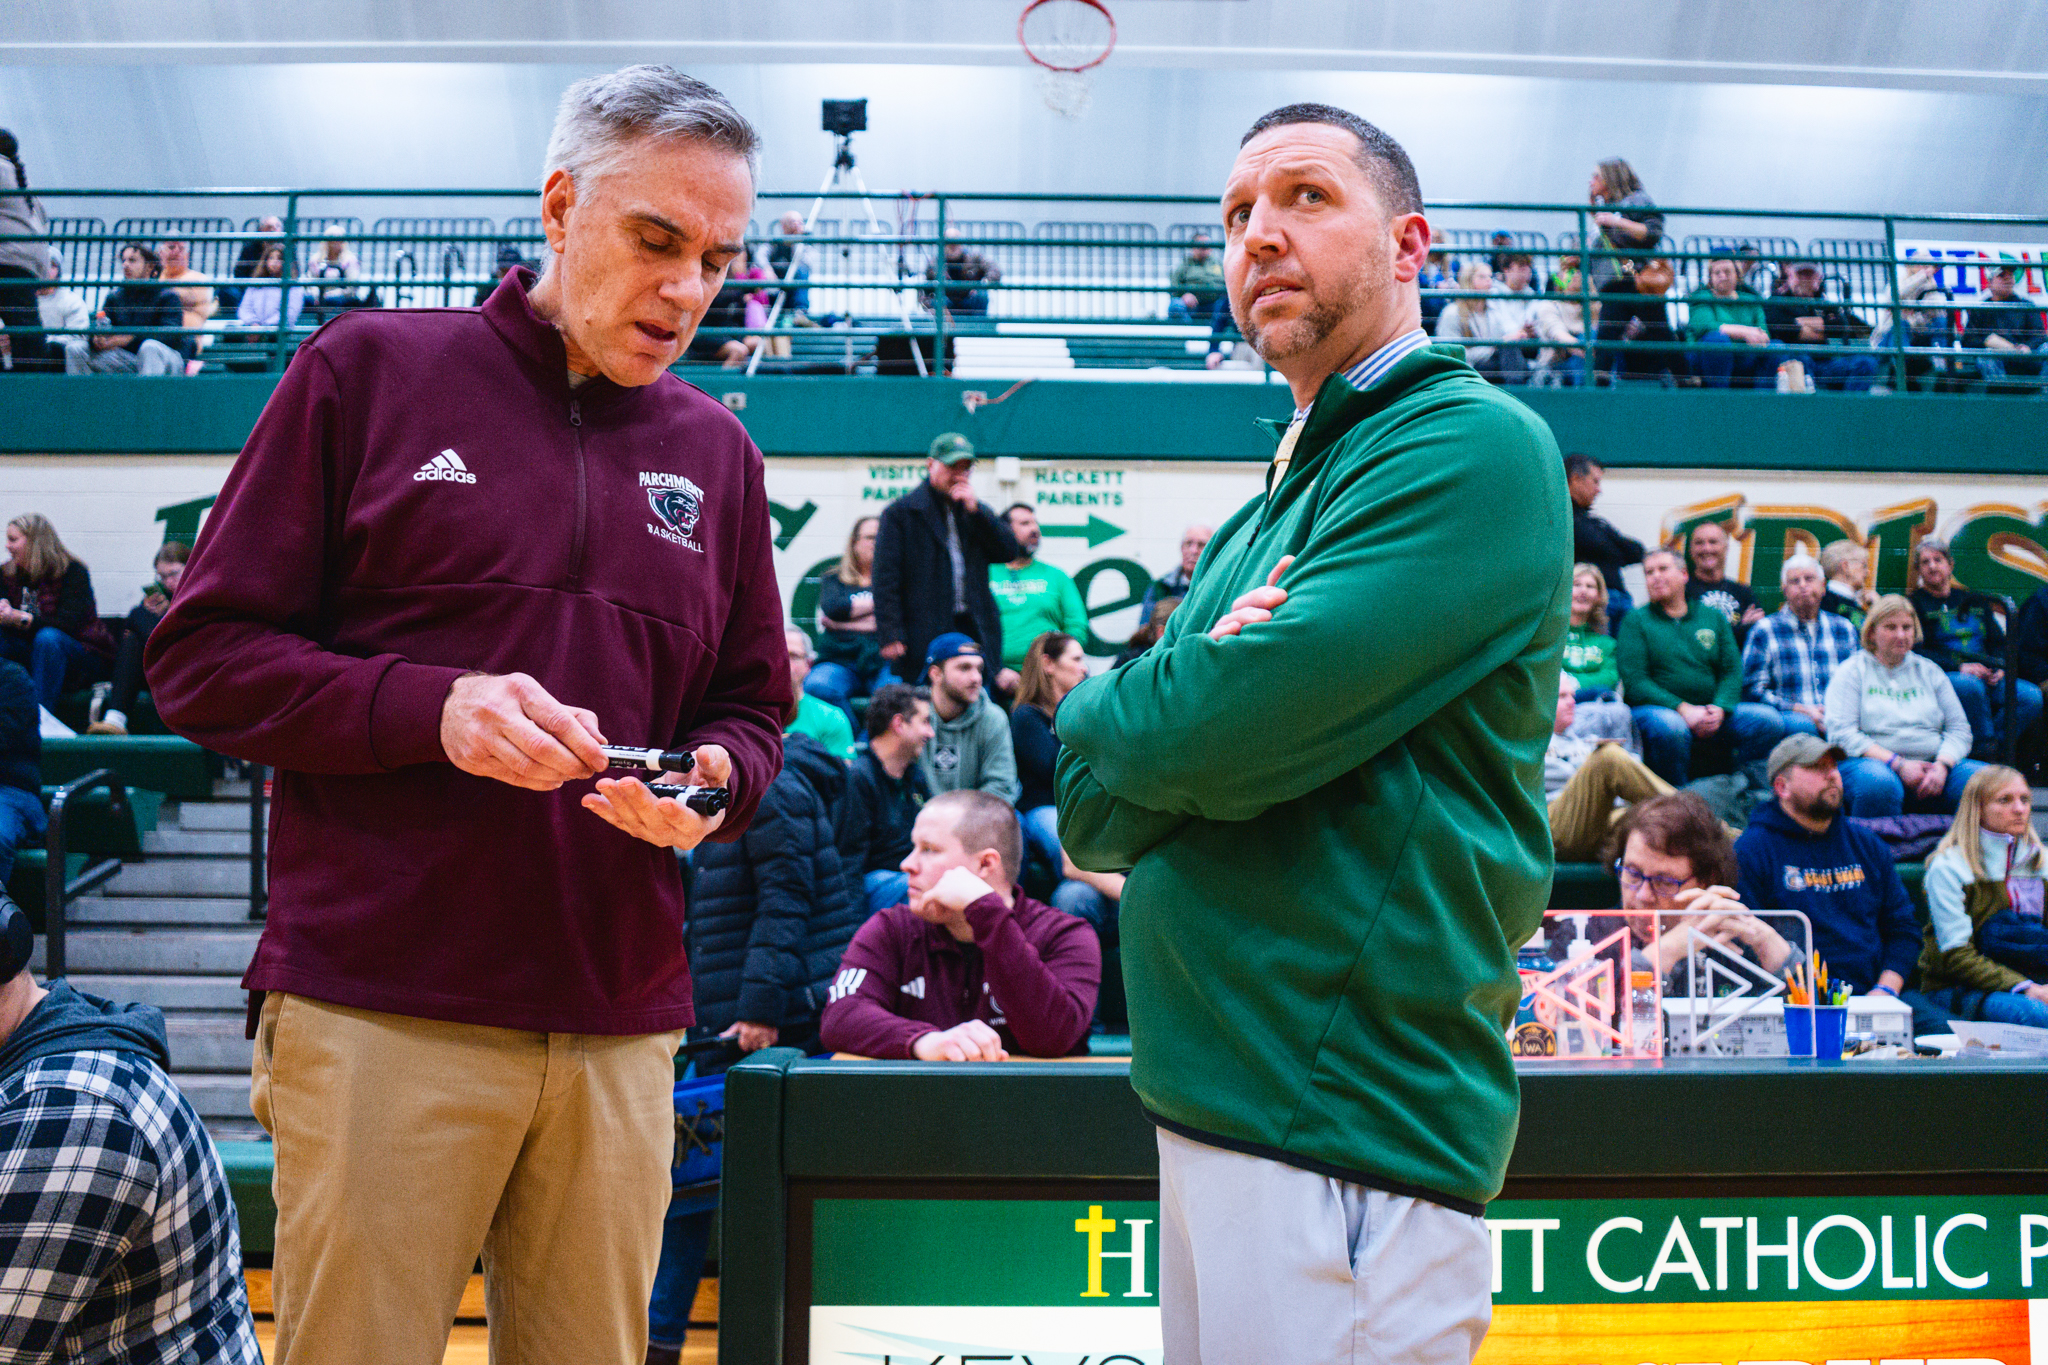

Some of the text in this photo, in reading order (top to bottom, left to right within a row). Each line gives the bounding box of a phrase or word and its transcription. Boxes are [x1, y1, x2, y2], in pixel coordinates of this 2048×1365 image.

[413, 467, 477, 484] adidas
[639, 471, 705, 503] PARCHMENT
[1035, 468, 1124, 484] HACKETT
[1037, 491, 1123, 506] PARENTS
[647, 523, 704, 553] BASKETBALL
[1586, 1213, 1989, 1293] CATHOLIC
